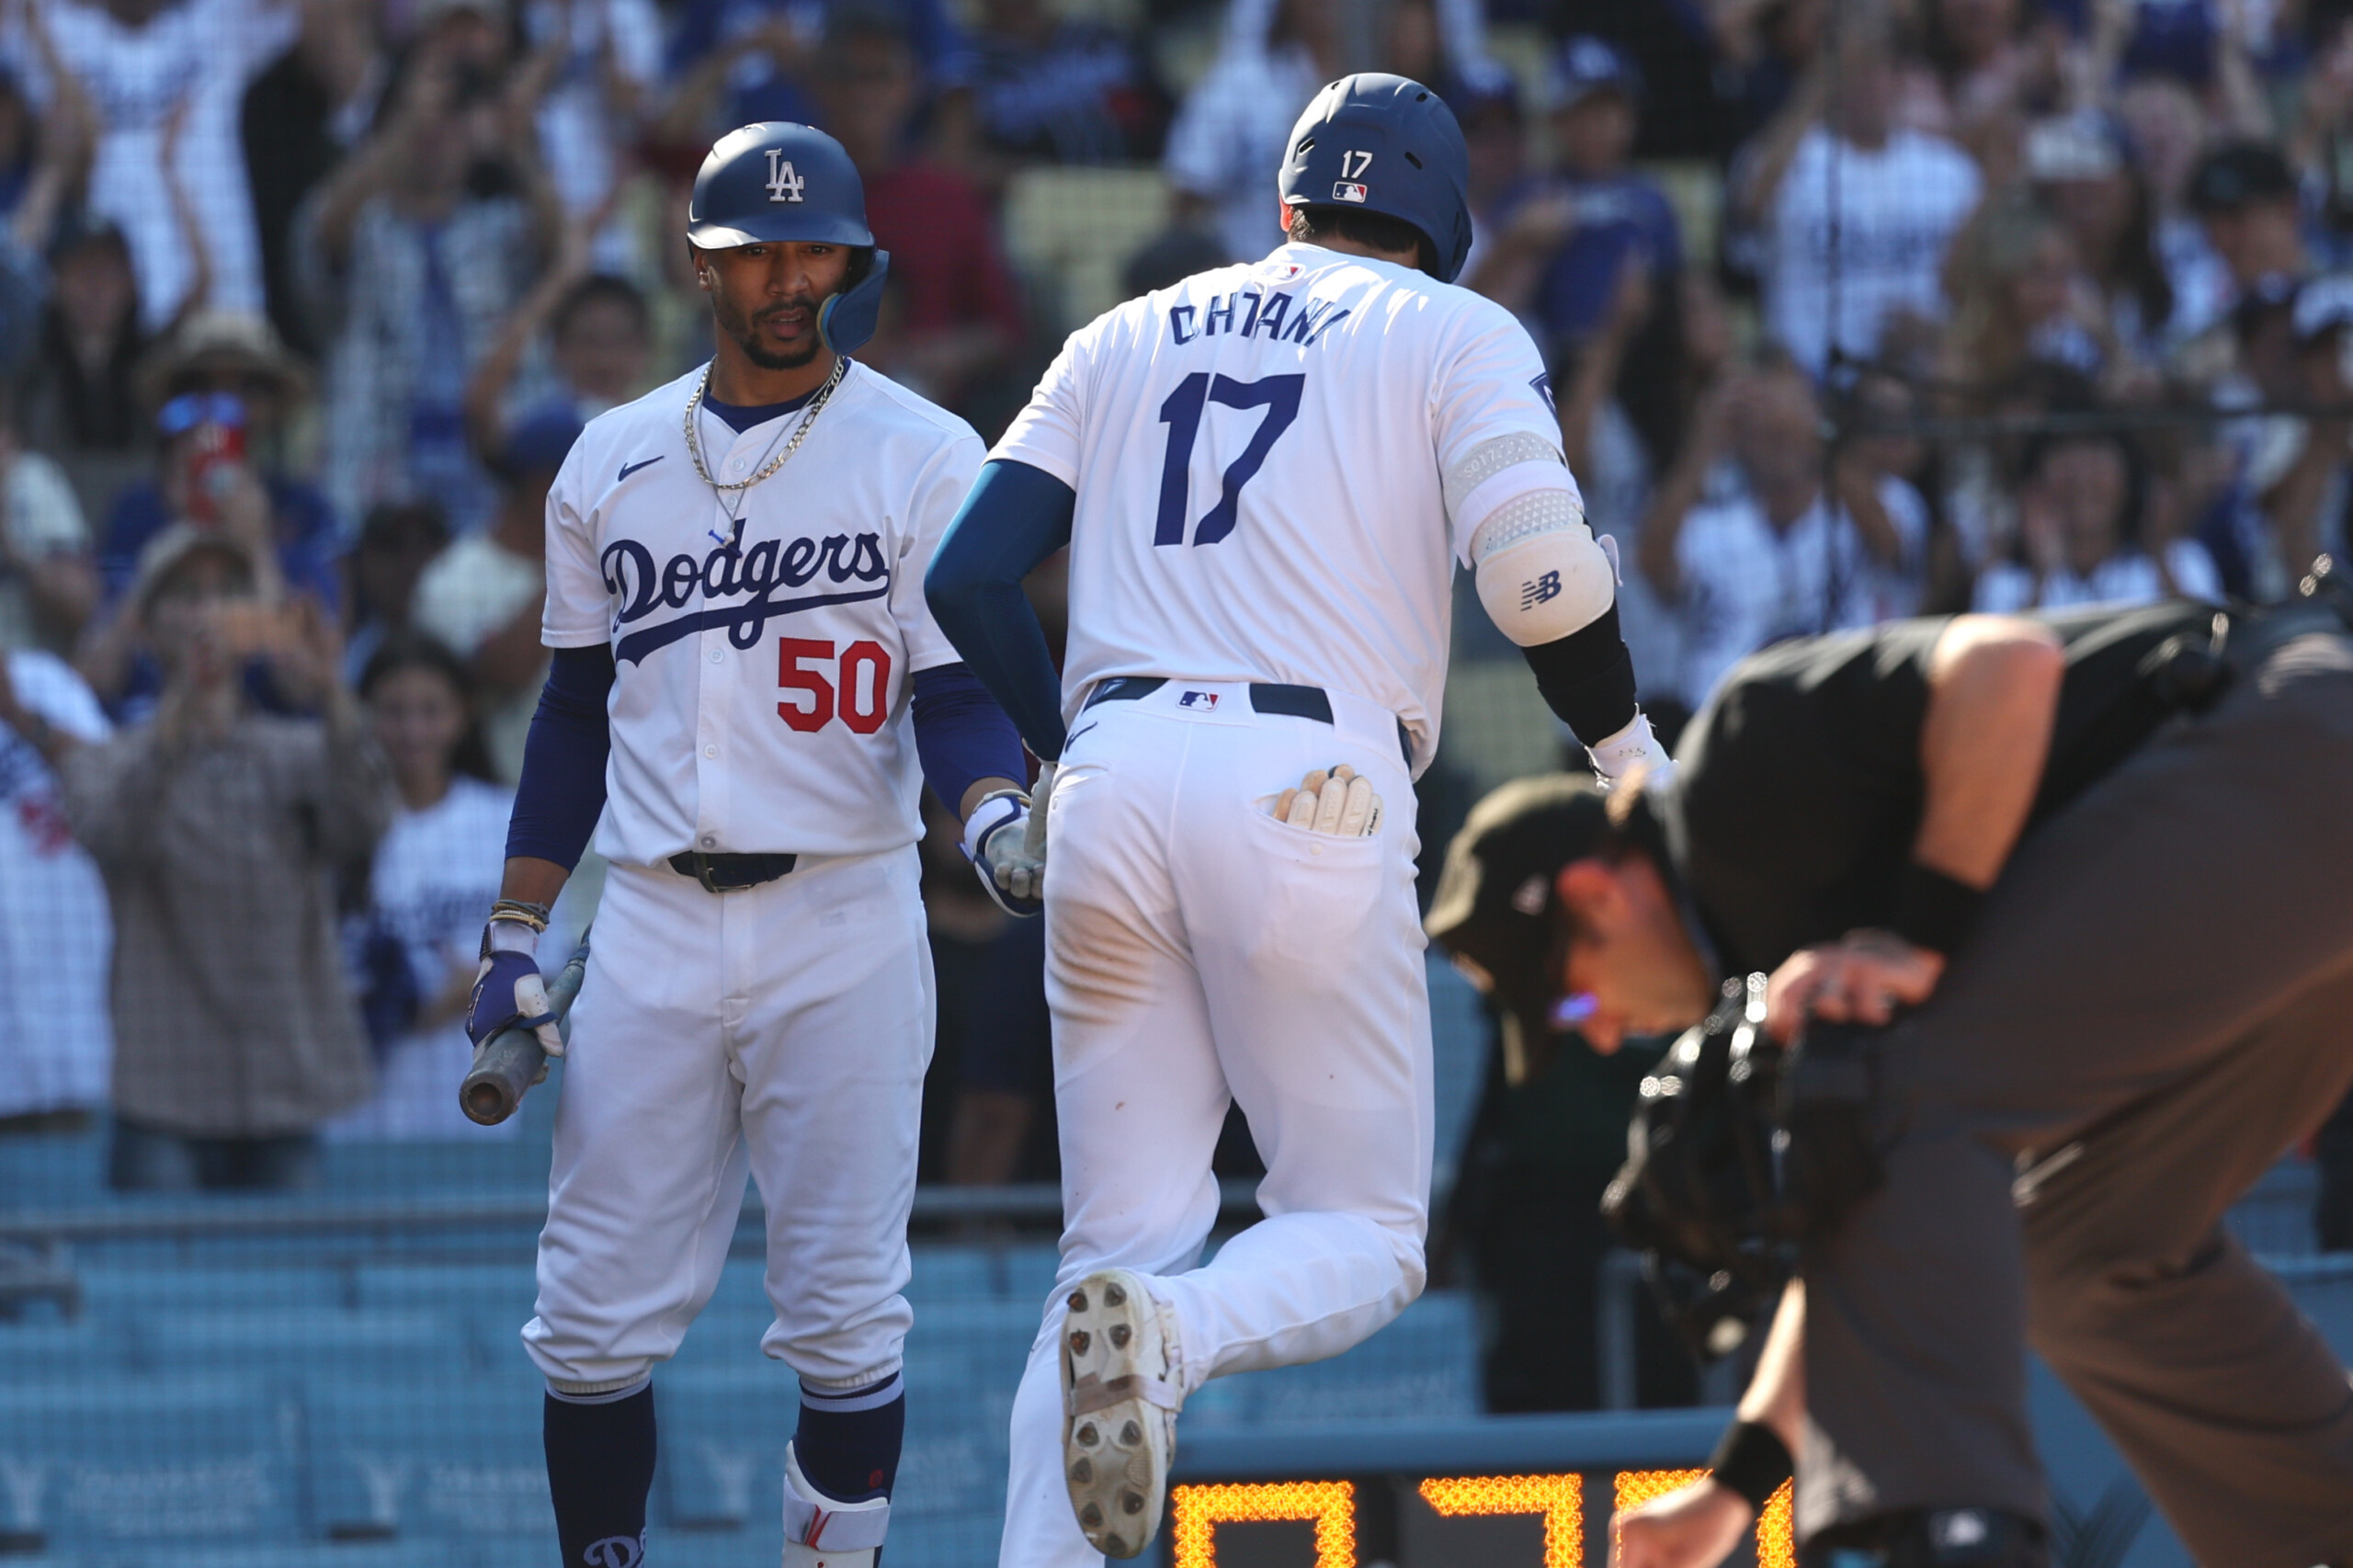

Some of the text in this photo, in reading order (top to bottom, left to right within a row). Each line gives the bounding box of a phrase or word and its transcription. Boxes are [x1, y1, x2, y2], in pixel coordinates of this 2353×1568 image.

[765, 148, 804, 202] LA
[1342, 150, 1372, 179] 17
[1154, 371, 1306, 547] 17
[600, 517, 890, 662] Dodgers
[778, 636, 891, 734] 50
